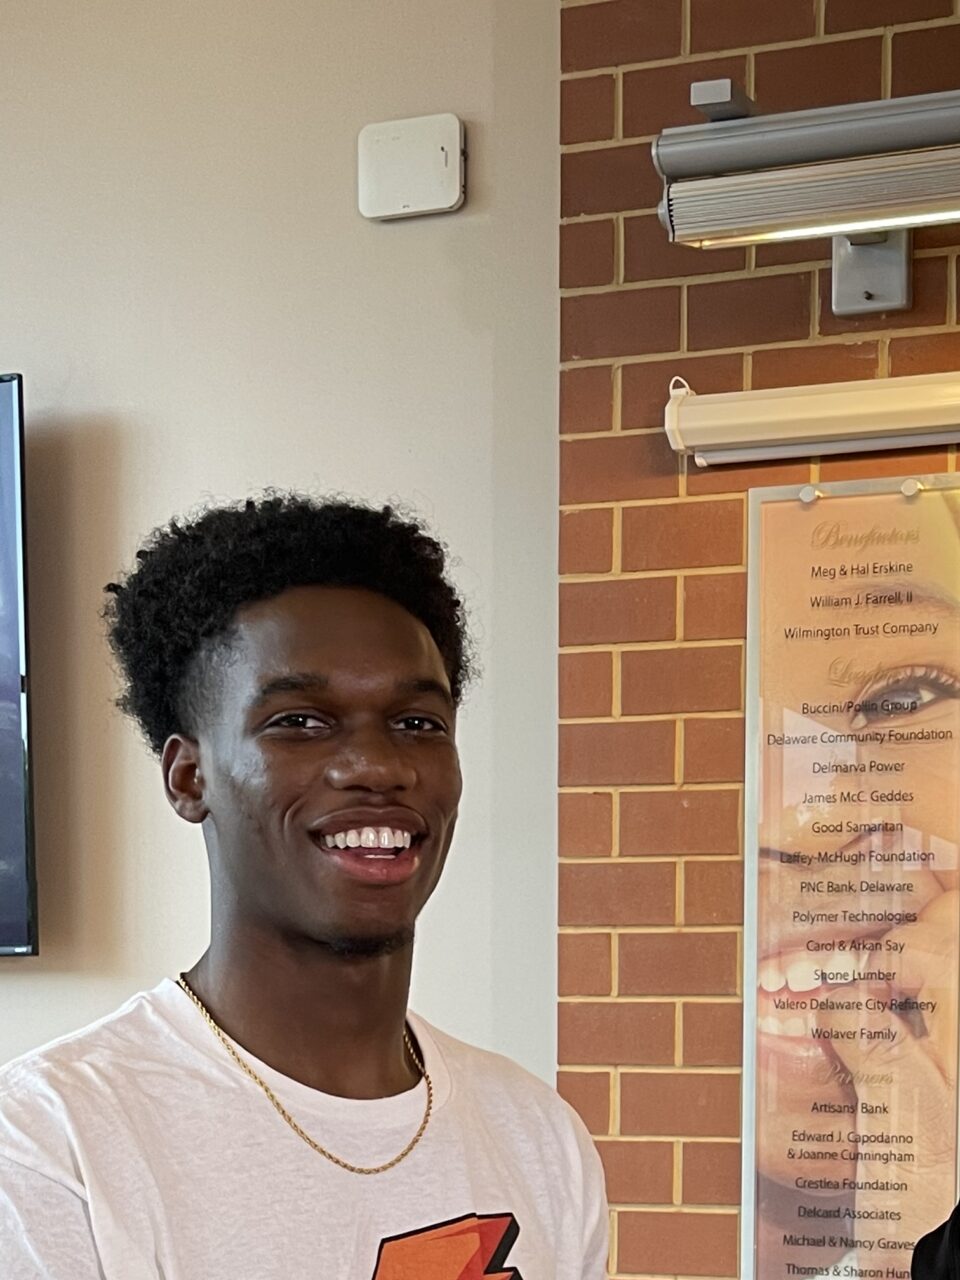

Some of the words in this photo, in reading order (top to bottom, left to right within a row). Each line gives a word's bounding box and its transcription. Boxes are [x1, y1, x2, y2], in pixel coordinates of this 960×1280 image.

[811, 566, 836, 580] Meg
[839, 565, 848, 577] &
[850, 563, 869, 575] Hal
[872, 561, 913, 574] Erskine
[810, 596, 851, 608] William
[784, 625, 850, 641] Wilmington
[853, 624, 879, 636] Trust
[883, 621, 938, 636] Company
[881, 700, 917, 714] Group
[767, 733, 817, 746] Delaware
[821, 732, 885, 746] Community
[888, 730, 952, 742] Foundation
[812, 762, 865, 774] Delmarva
[869, 761, 905, 773] Power
[803, 793, 836, 804] James
[870, 790, 914, 802] Geddes
[812, 822, 842, 833] Good
[846, 821, 903, 833] Samaritan
[779, 851, 865, 866] Laffey-McHugh
[869, 850, 935, 862] Foundation
[800, 881, 824, 893] PNC
[827, 881, 857, 893] Bank,
[860, 881, 914, 892] Delaware
[792, 911, 838, 924] Polymer
[842, 910, 917, 924] Technologies
[806, 940, 835, 951] Carol
[838, 940, 847, 951] &
[849, 940, 882, 951] Arkan
[885, 940, 905, 954] Say
[852, 969, 896, 981] Lumber
[773, 999, 807, 1010] Valero
[810, 999, 862, 1010] Delaware
[865, 999, 887, 1013] City
[890, 999, 937, 1013] Refinery
[811, 1028, 856, 1040] Wolaver
[860, 1028, 897, 1042] Family
[861, 1102, 889, 1114] Bank
[792, 1130, 834, 1142] Edward
[837, 1131, 845, 1142] J.
[847, 1132, 913, 1145] Capodanno
[787, 1149, 795, 1159] &
[797, 1149, 838, 1161] Joanne
[841, 1150, 915, 1164] Cunningham
[795, 1177, 840, 1190] Crestlea
[843, 1178, 908, 1191] Foundation
[843, 1207, 902, 1221] Associates
[783, 1235, 826, 1247] Michael
[829, 1236, 837, 1248] &
[839, 1237, 875, 1251] Nancy
[785, 1263, 830, 1276] Thomas
[833, 1264, 841, 1276] &
[843, 1265, 883, 1278] Sharon
